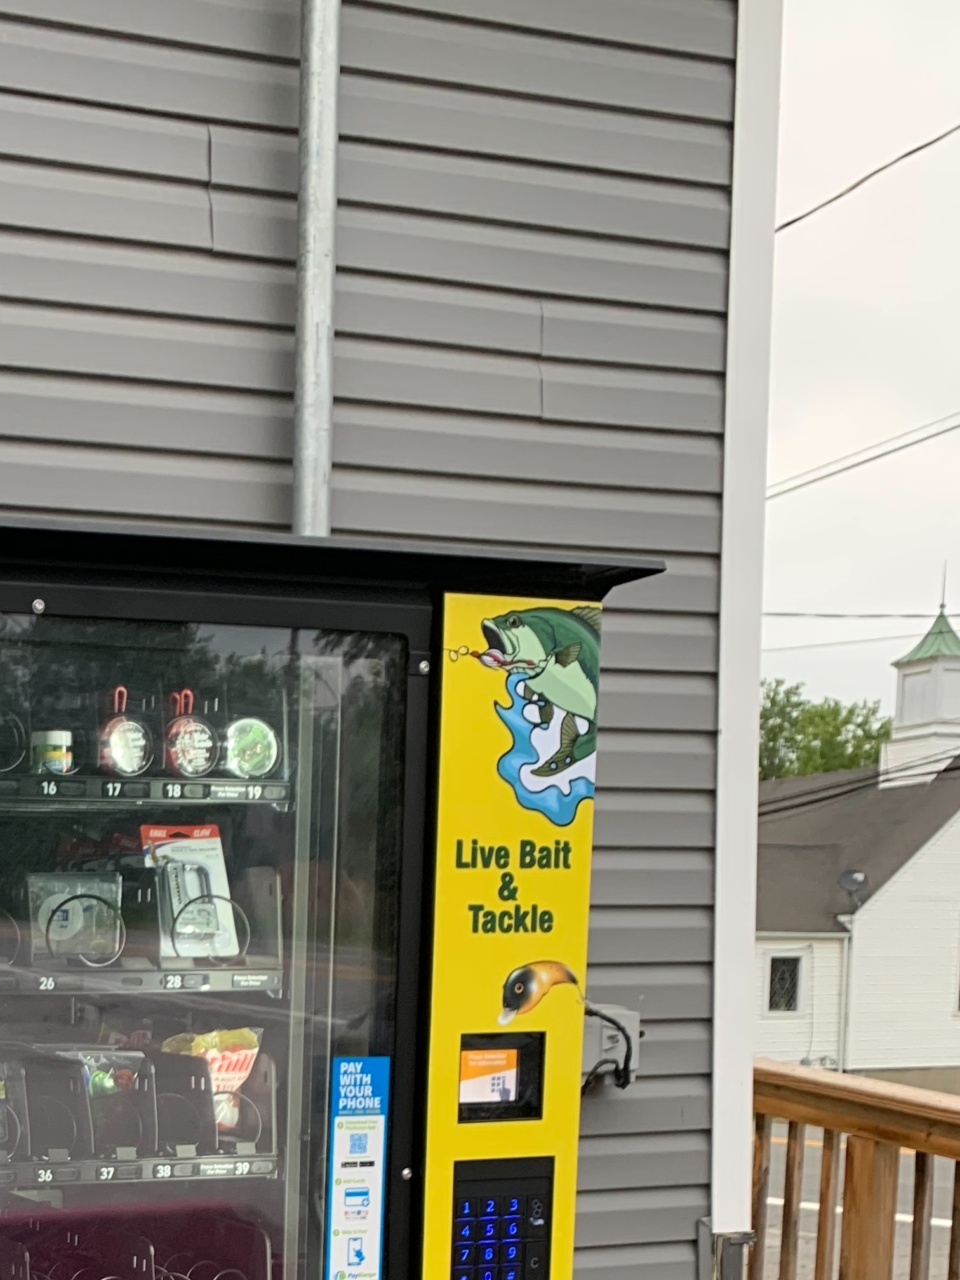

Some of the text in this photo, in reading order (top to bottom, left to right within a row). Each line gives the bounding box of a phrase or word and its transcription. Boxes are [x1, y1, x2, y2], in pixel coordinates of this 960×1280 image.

[42, 781, 57, 795] 16
[106, 783, 121, 796] 17
[166, 784, 181, 798] 18
[247, 785, 262, 800] 19
[455, 839, 572, 870] Live Bait
[498, 872, 518, 901] &
[468, 904, 554, 934] Tackle
[40, 977, 55, 990] 26
[166, 975, 182, 988] 28
[340, 1062, 363, 1074] PAY
[339, 1074, 371, 1086] WITH
[338, 1086, 372, 1098] YOUR
[338, 1097, 381, 1109] PHONE
[100, 1167, 114, 1180] 37
[156, 1164, 171, 1178] 38
[235, 1162, 250, 1175] 39
[38, 1169, 53, 1182] 36
[464, 1199, 518, 1214] 1 2 3
[462, 1223, 517, 1237] 4 5 6
[461, 1246, 516, 1261] 7 8 9
